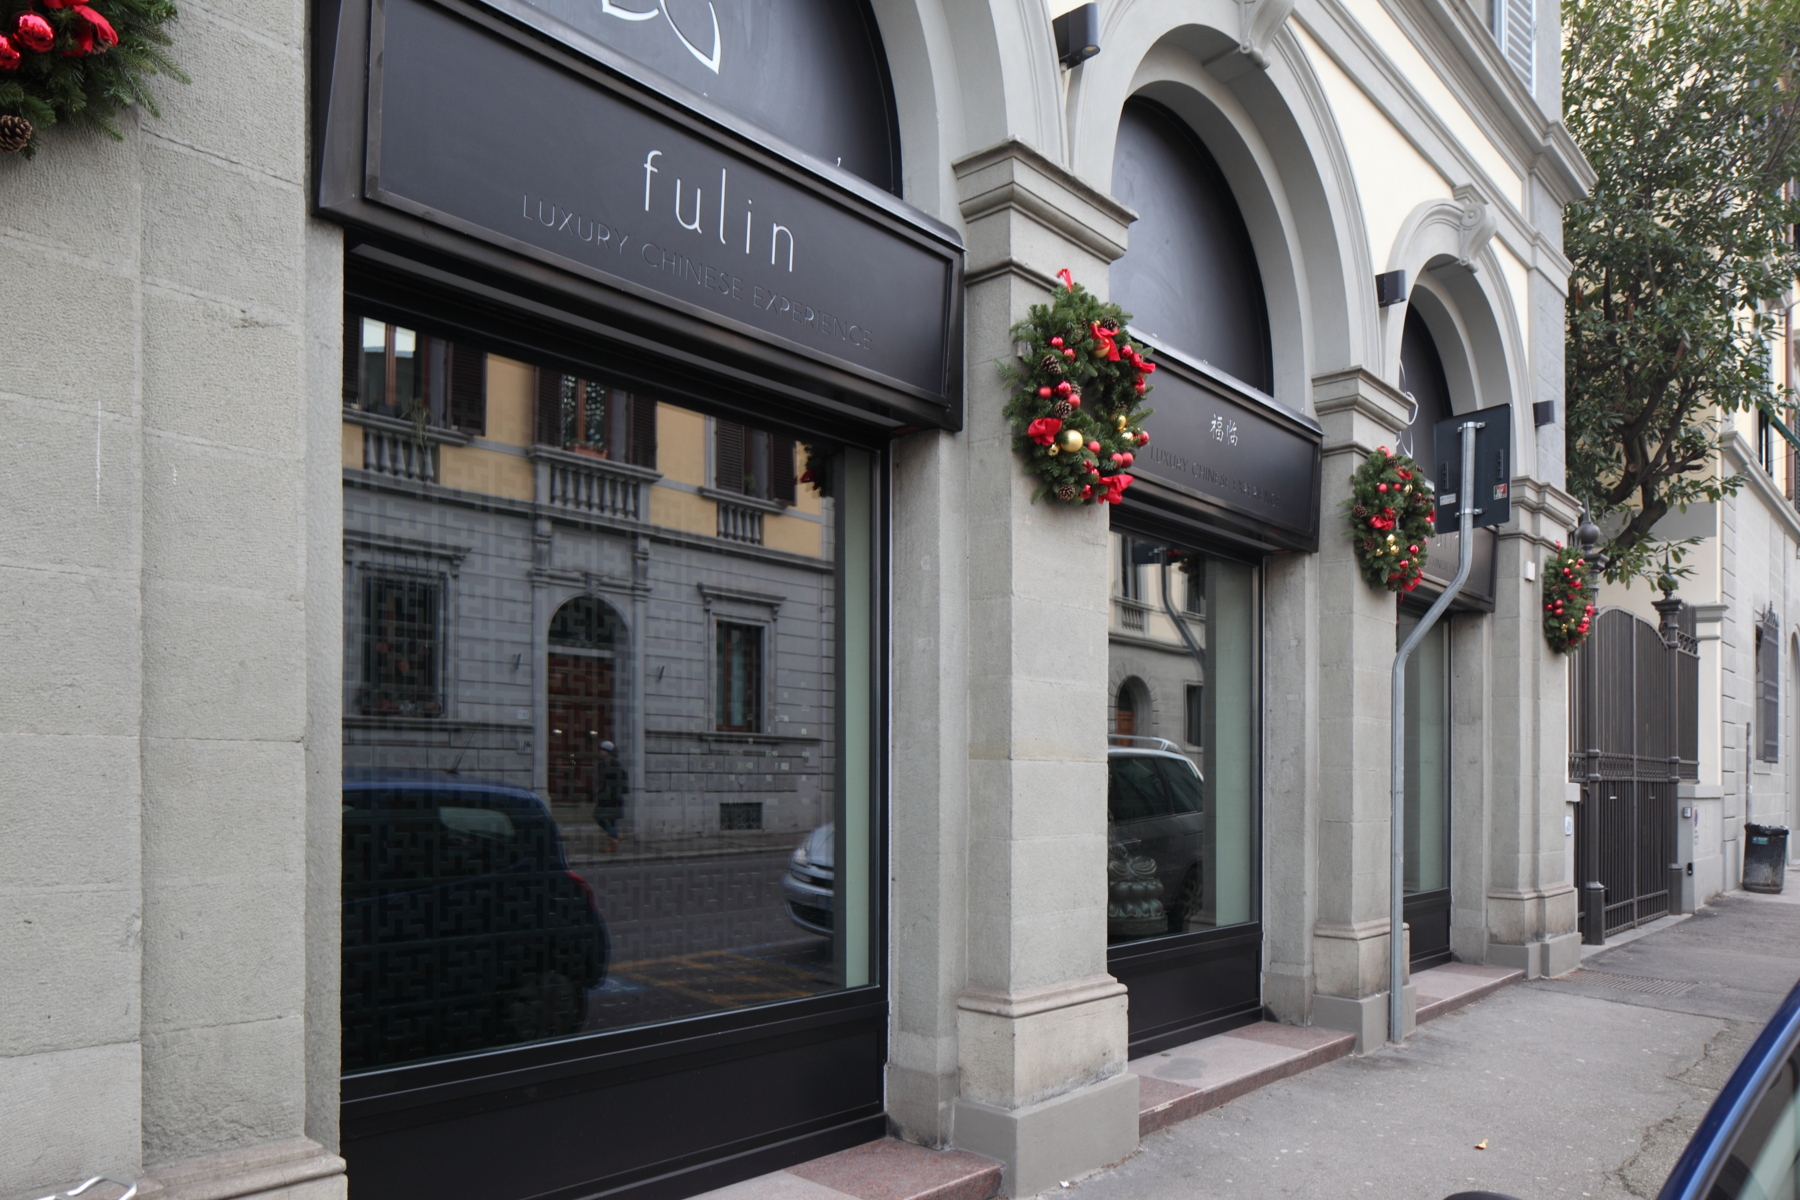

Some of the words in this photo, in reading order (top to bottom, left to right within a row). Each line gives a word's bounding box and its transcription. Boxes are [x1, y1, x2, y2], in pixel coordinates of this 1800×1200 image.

[522, 192, 630, 255] LUXURY
[641, 242, 744, 301] CHINESE
[753, 284, 874, 351] EXPERIENCE
[643, 149, 795, 273] fulin
[1150, 445, 1189, 473] LUXURY
[1191, 462, 1230, 490] CHINESE
[1232, 478, 1280, 509] EXPERIENCE
